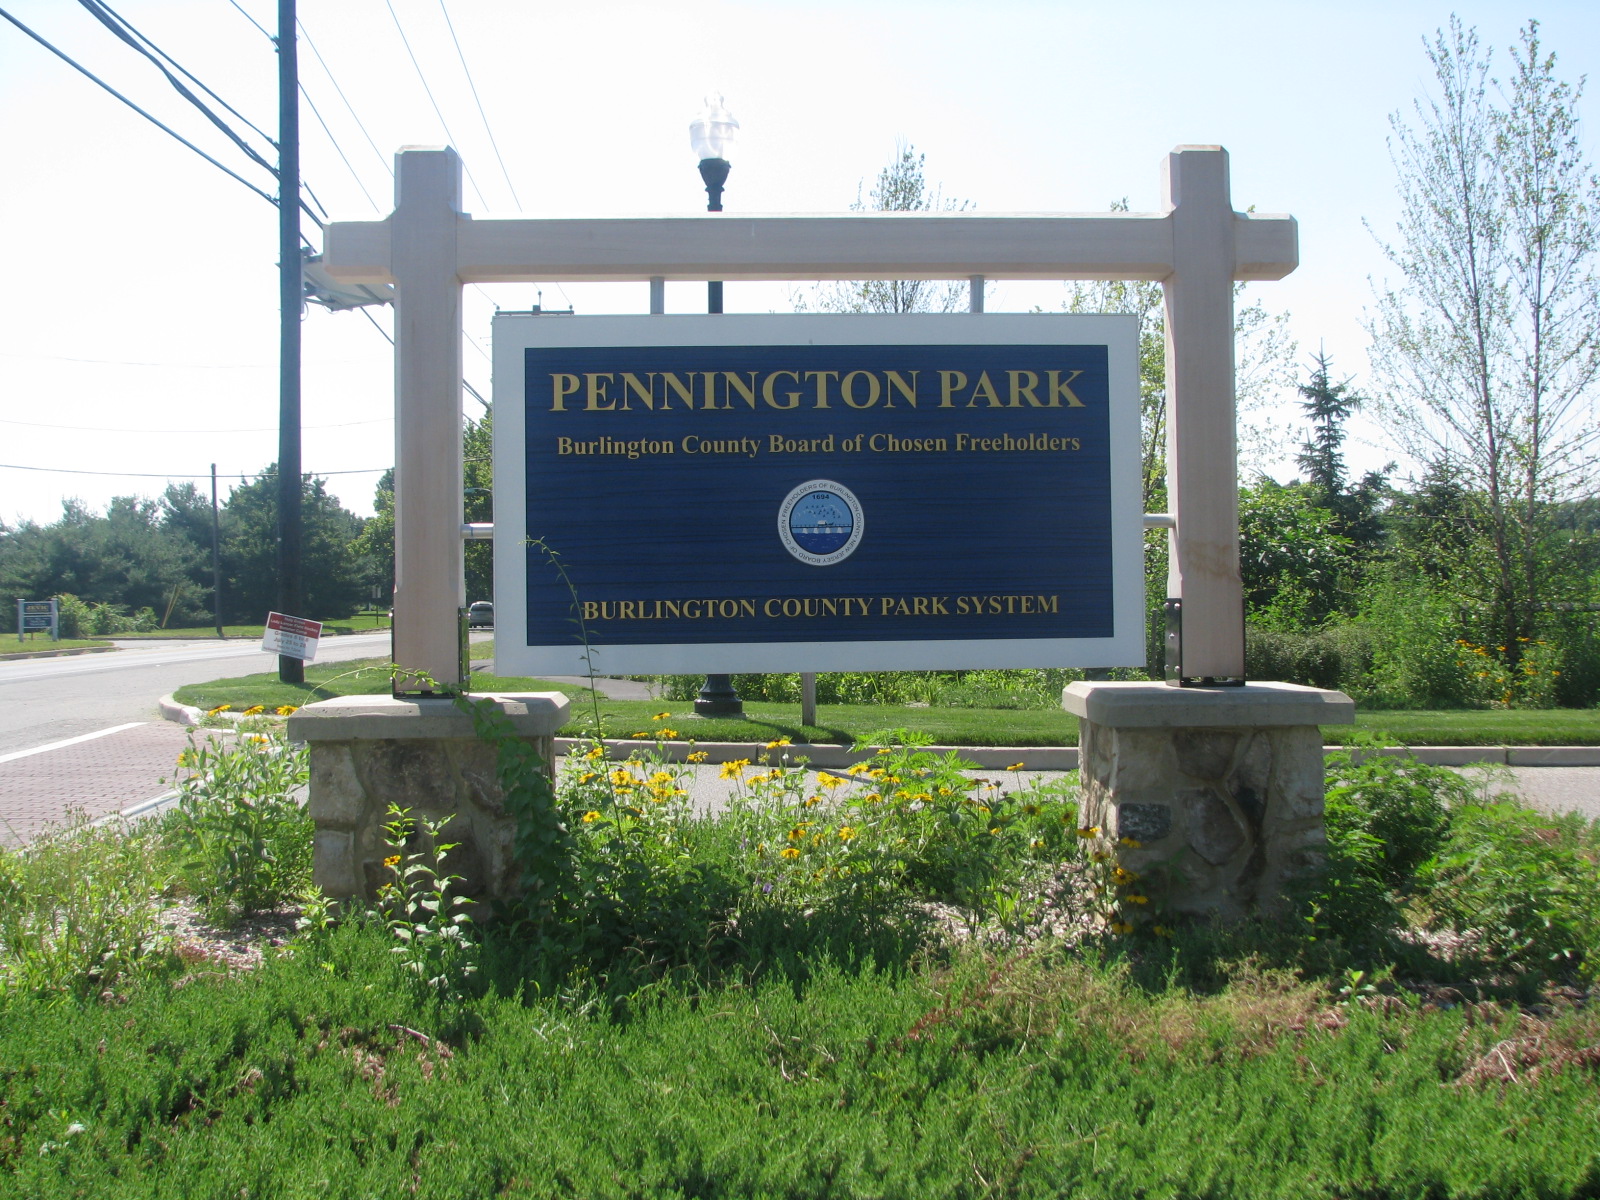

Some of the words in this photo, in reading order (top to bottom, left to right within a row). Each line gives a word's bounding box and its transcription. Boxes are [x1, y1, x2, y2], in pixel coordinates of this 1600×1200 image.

[548, 369, 921, 412] PENNINGTON
[936, 369, 1087, 408] PARK
[557, 436, 675, 460] Burlington
[681, 435, 762, 458] County
[768, 433, 835, 453] Board
[841, 433, 864, 452] of
[868, 433, 948, 452] Chosen
[955, 432, 1081, 451] Freeholders
[781, 483, 818, 518] FREEHOLDERS
[829, 484, 860, 513] BURLINGTON
[853, 512, 862, 538] COUNTY
[583, 598, 757, 621] BURLINGTON
[764, 597, 873, 617] COUNTY
[880, 596, 949, 615] PARK
[956, 595, 1060, 615] SYSTEM
